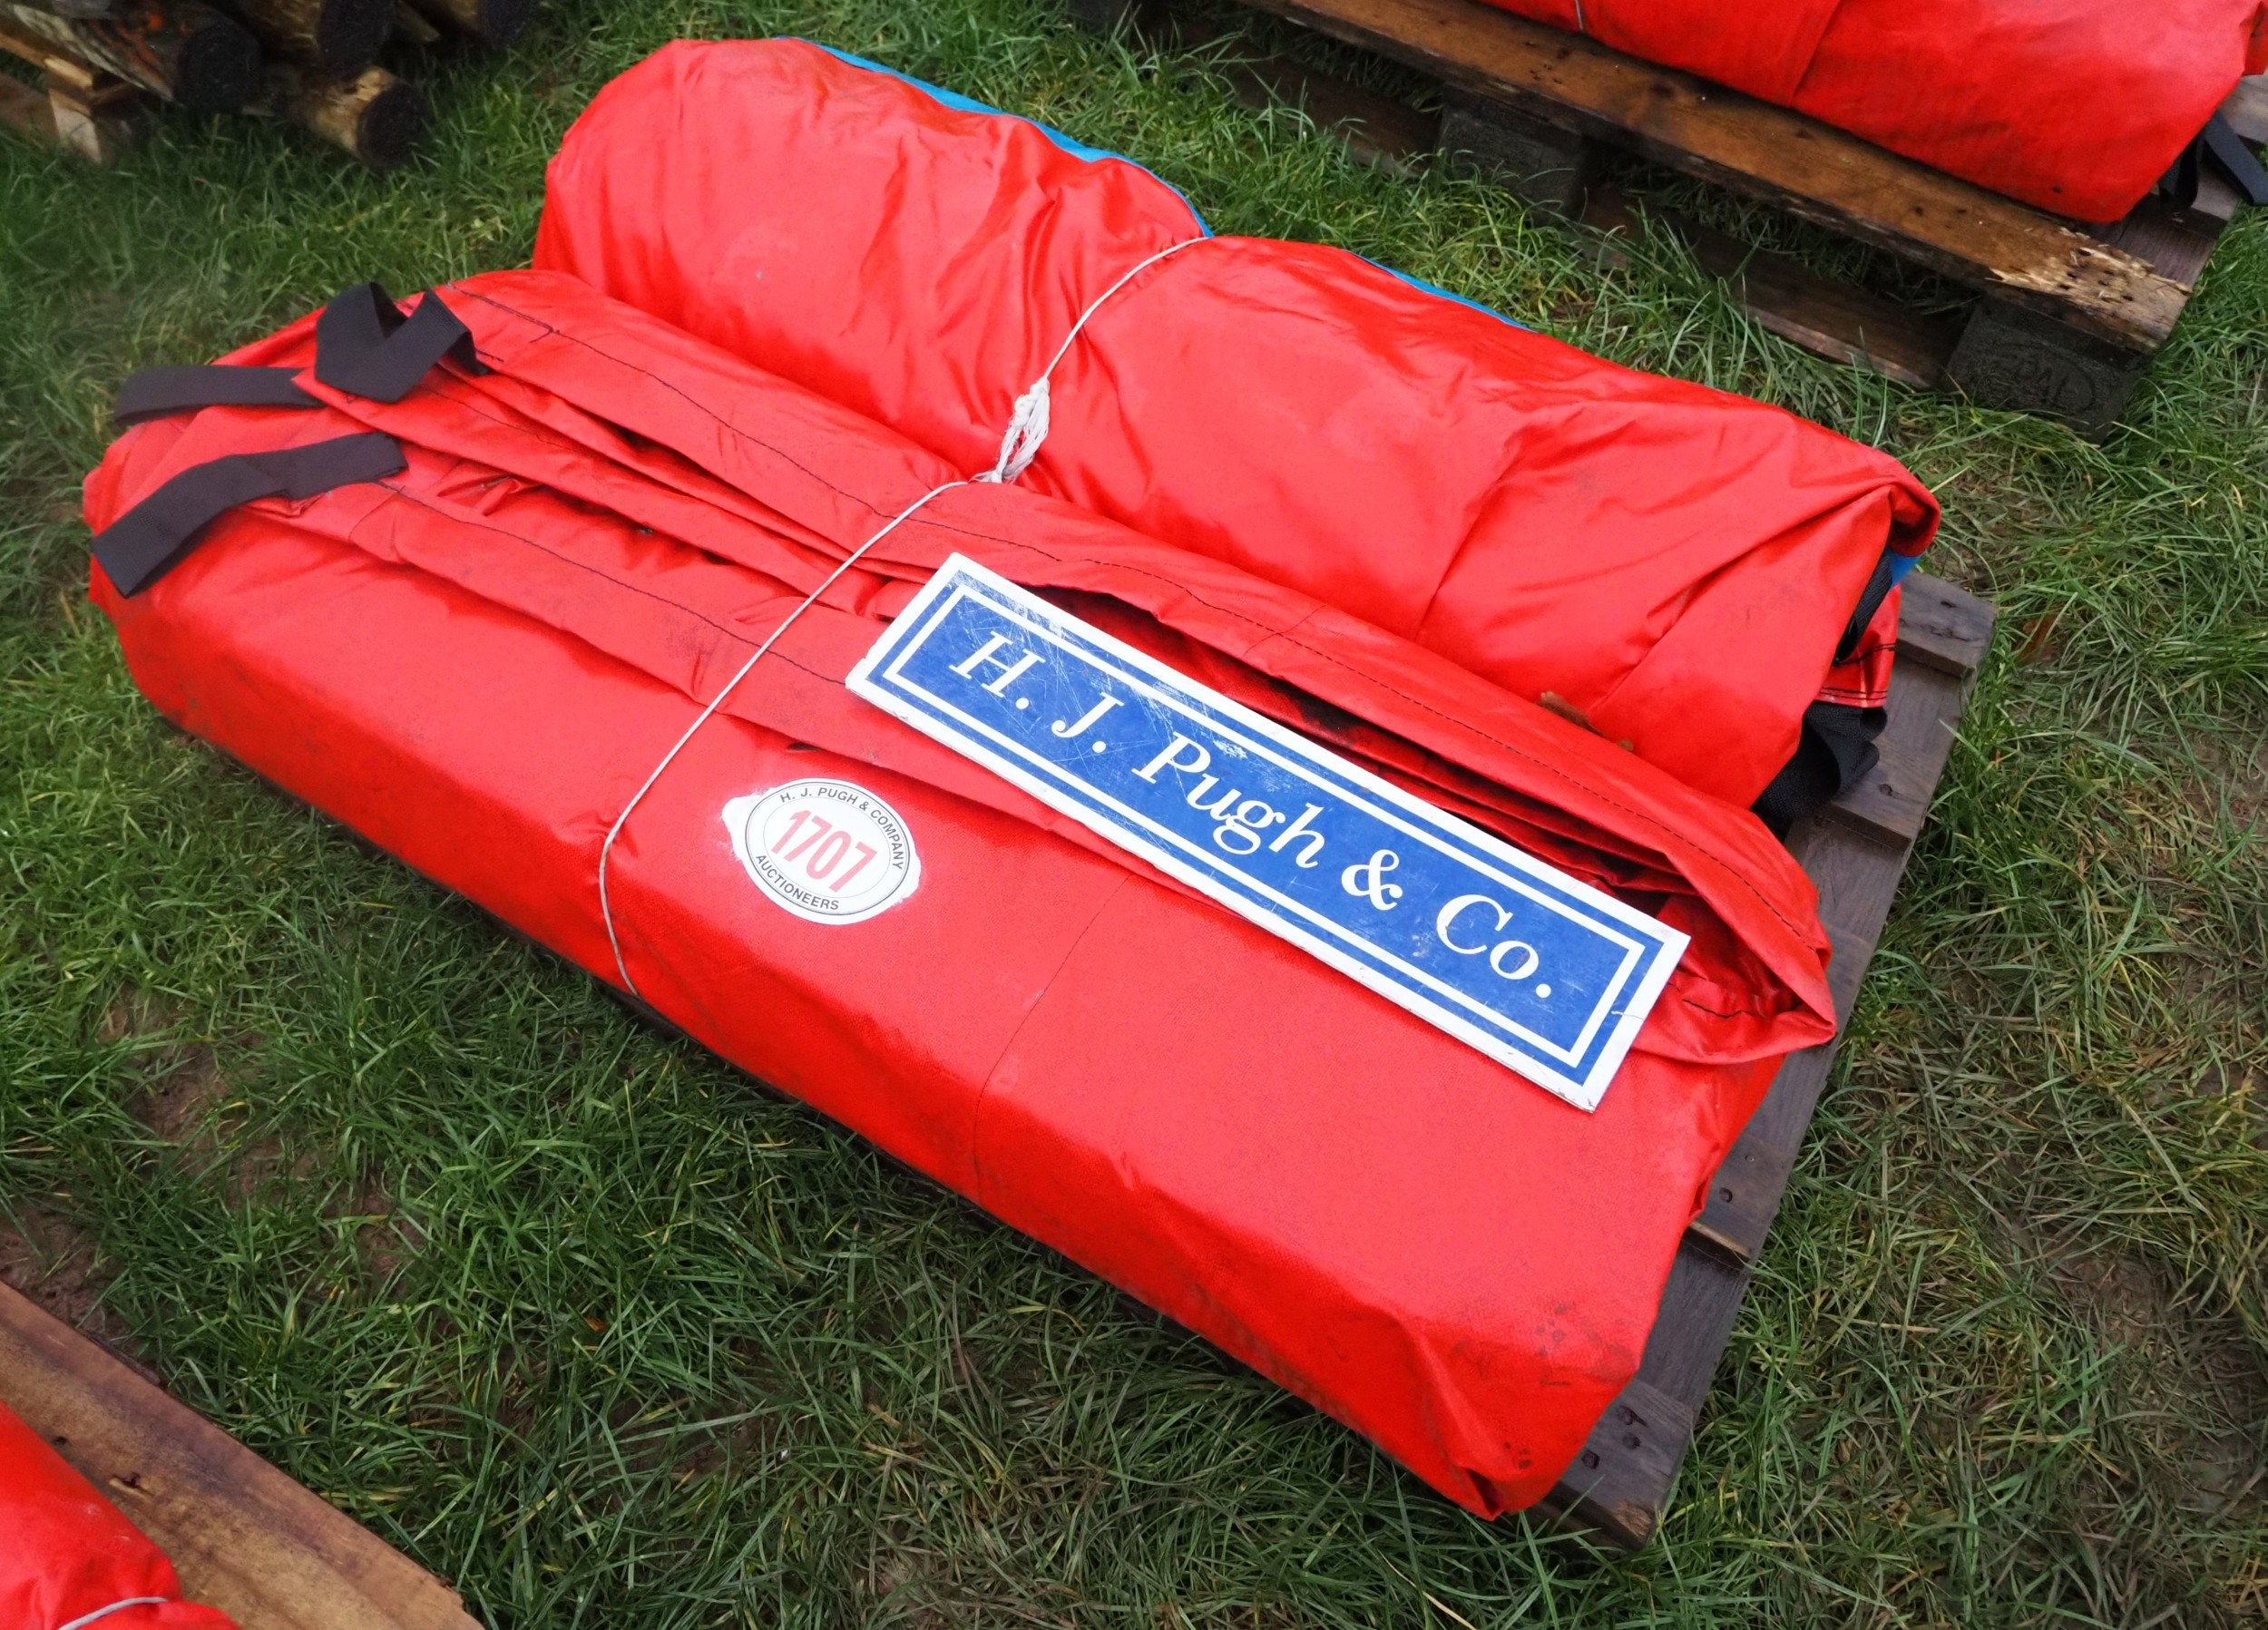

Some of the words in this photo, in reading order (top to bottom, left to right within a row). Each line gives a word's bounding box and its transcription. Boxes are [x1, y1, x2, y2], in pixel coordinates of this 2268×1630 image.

[771, 810, 878, 893] 1707
[780, 793, 796, 804] H.
[800, 787, 812, 797] J.
[817, 786, 858, 805] PUGH
[858, 801, 870, 812] &
[870, 809, 904, 871] COMPANY
[949, 630, 1046, 711] H.
[1051, 692, 1124, 755] J.
[1131, 731, 1325, 870] Pugh
[1340, 849, 1404, 913] &
[1435, 893, 1553, 1000] Co.
[756, 854, 840, 911] AUCTIONEERS
